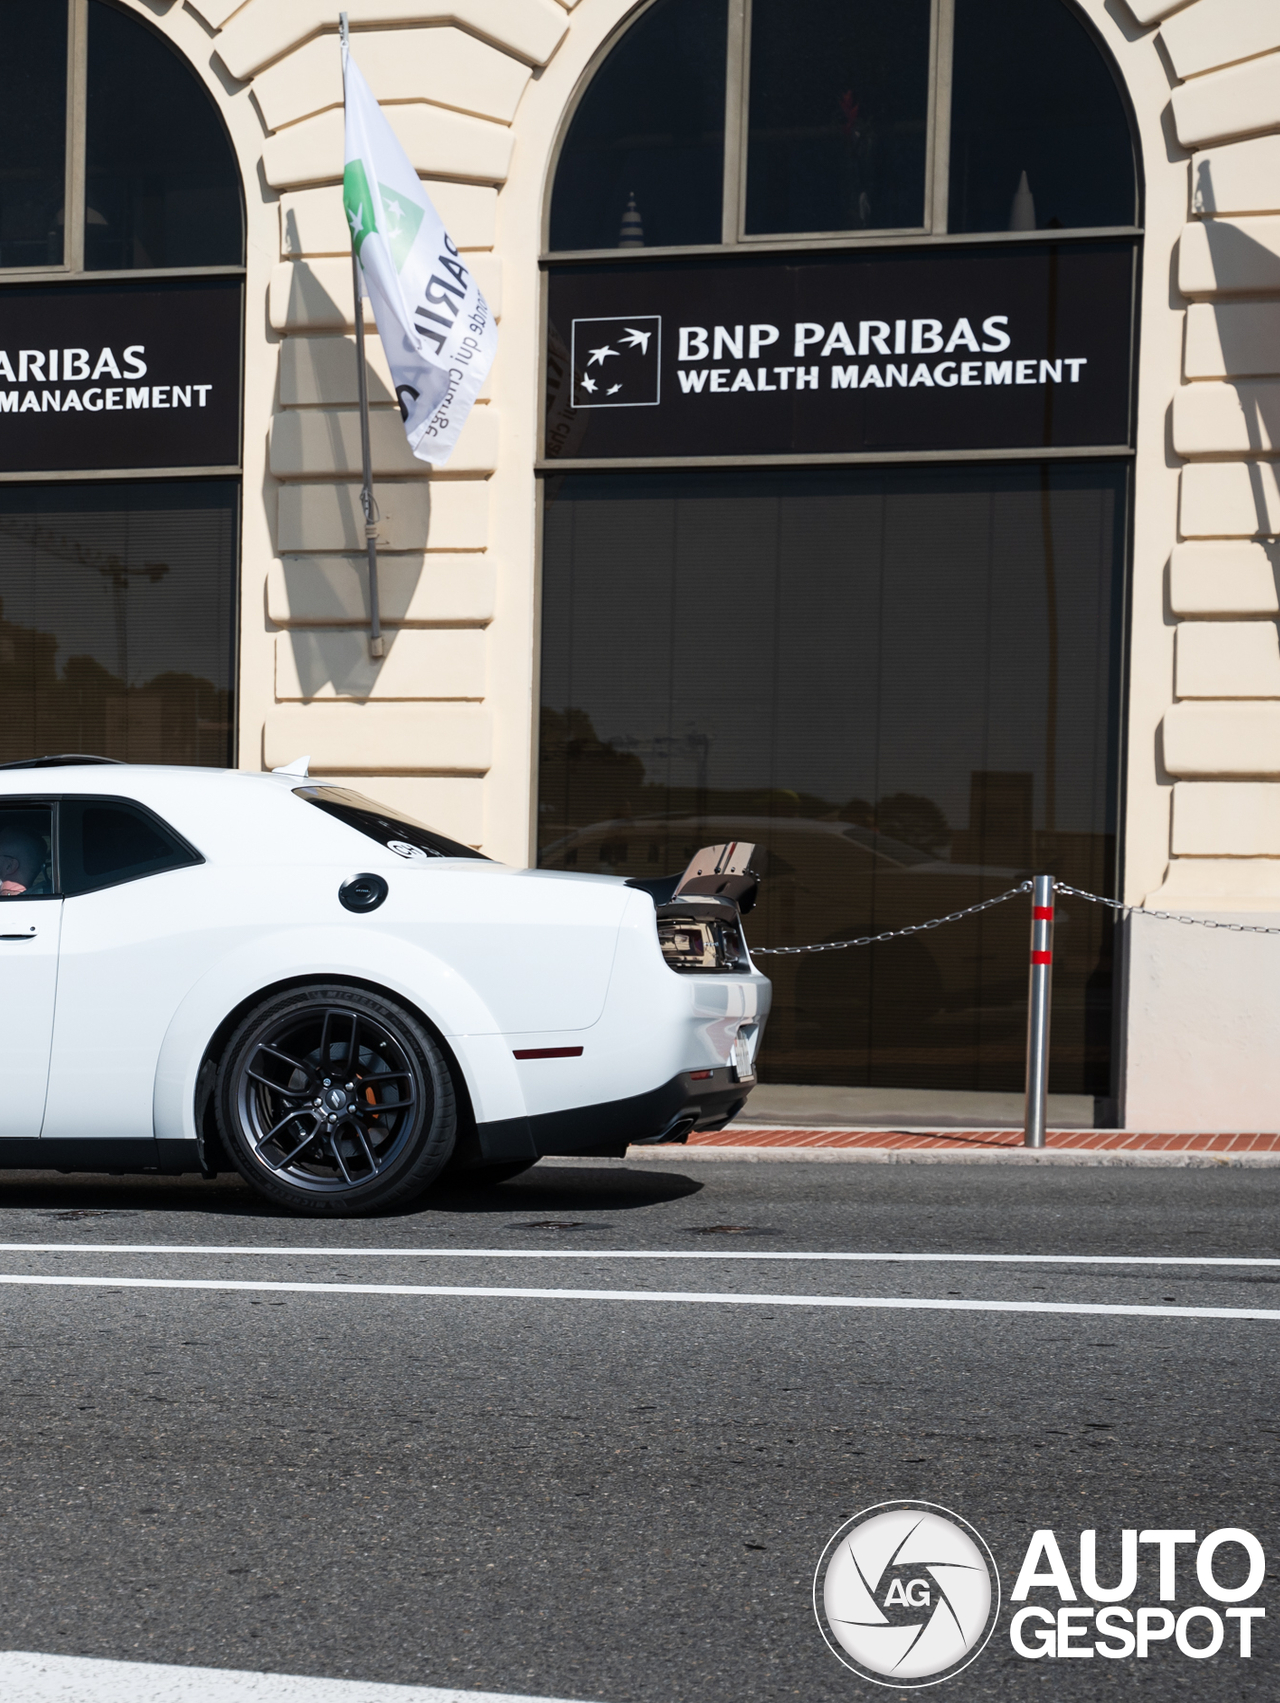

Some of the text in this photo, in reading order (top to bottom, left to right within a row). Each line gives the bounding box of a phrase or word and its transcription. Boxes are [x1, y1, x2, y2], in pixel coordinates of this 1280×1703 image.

[677, 315, 1011, 361] BNP PARIBAS
[677, 357, 1088, 394] WEALTH MANAGEMENT
[326, 990, 388, 1017] MICHELIN
